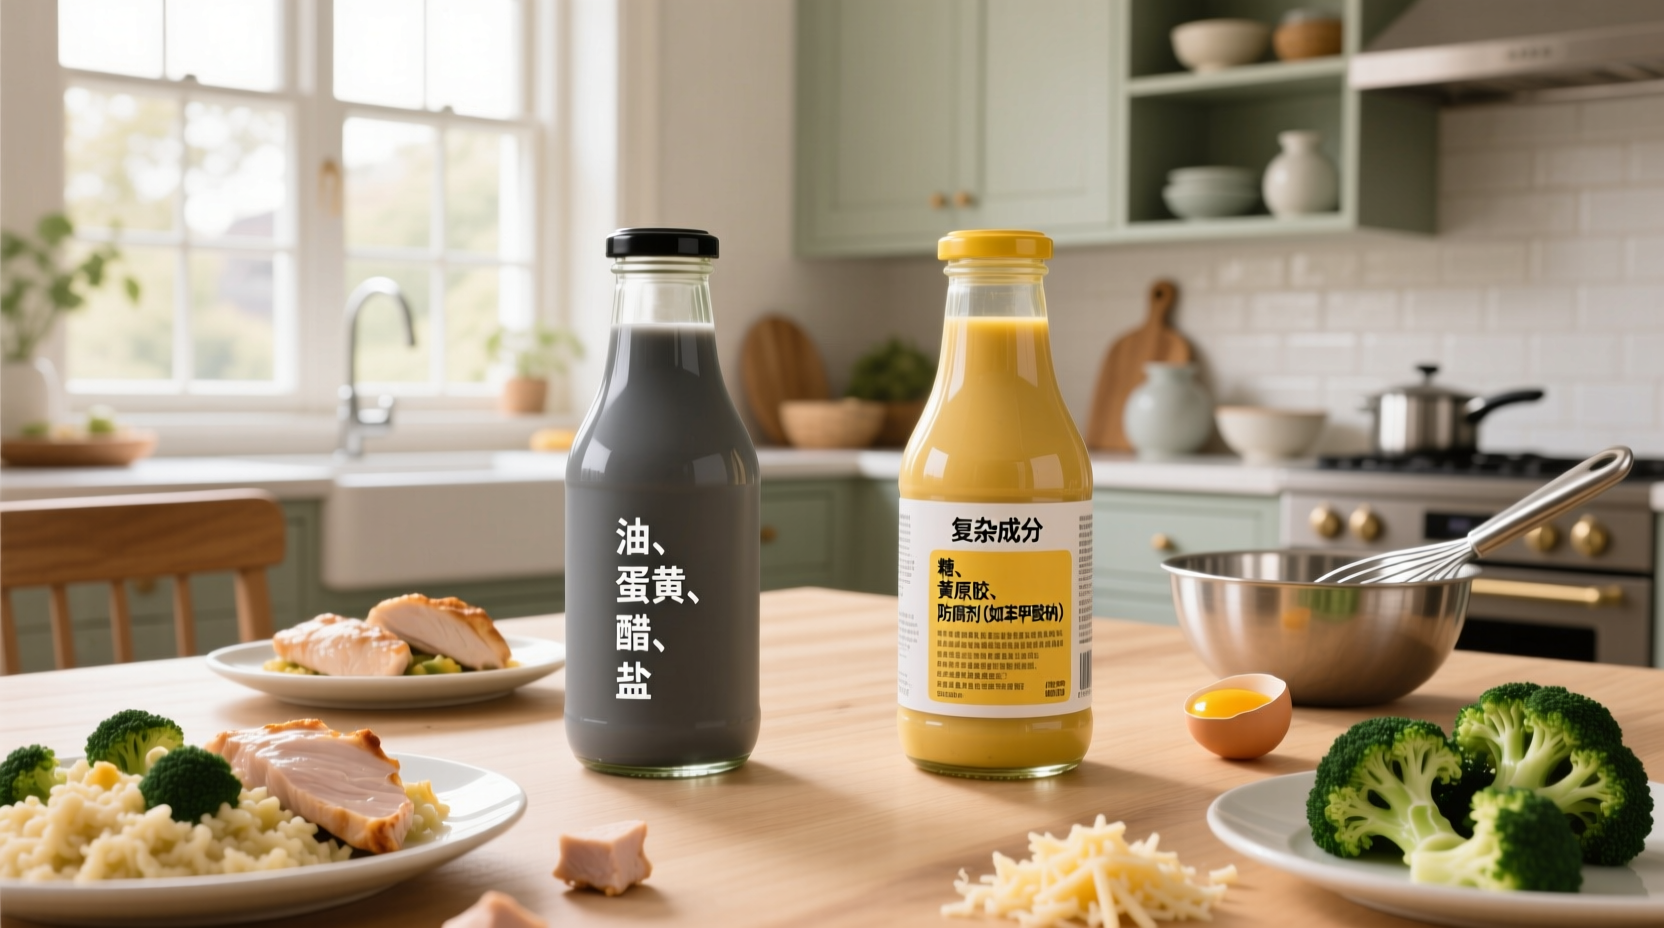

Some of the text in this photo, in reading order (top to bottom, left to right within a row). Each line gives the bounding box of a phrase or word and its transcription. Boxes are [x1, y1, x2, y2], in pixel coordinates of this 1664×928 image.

[616, 517, 664, 555] 油、
[952, 517, 1043, 543] 复杂成分
[616, 566, 699, 604] 蛋黄、
[616, 614, 664, 652] 醋、
[616, 662, 651, 699] 盐
